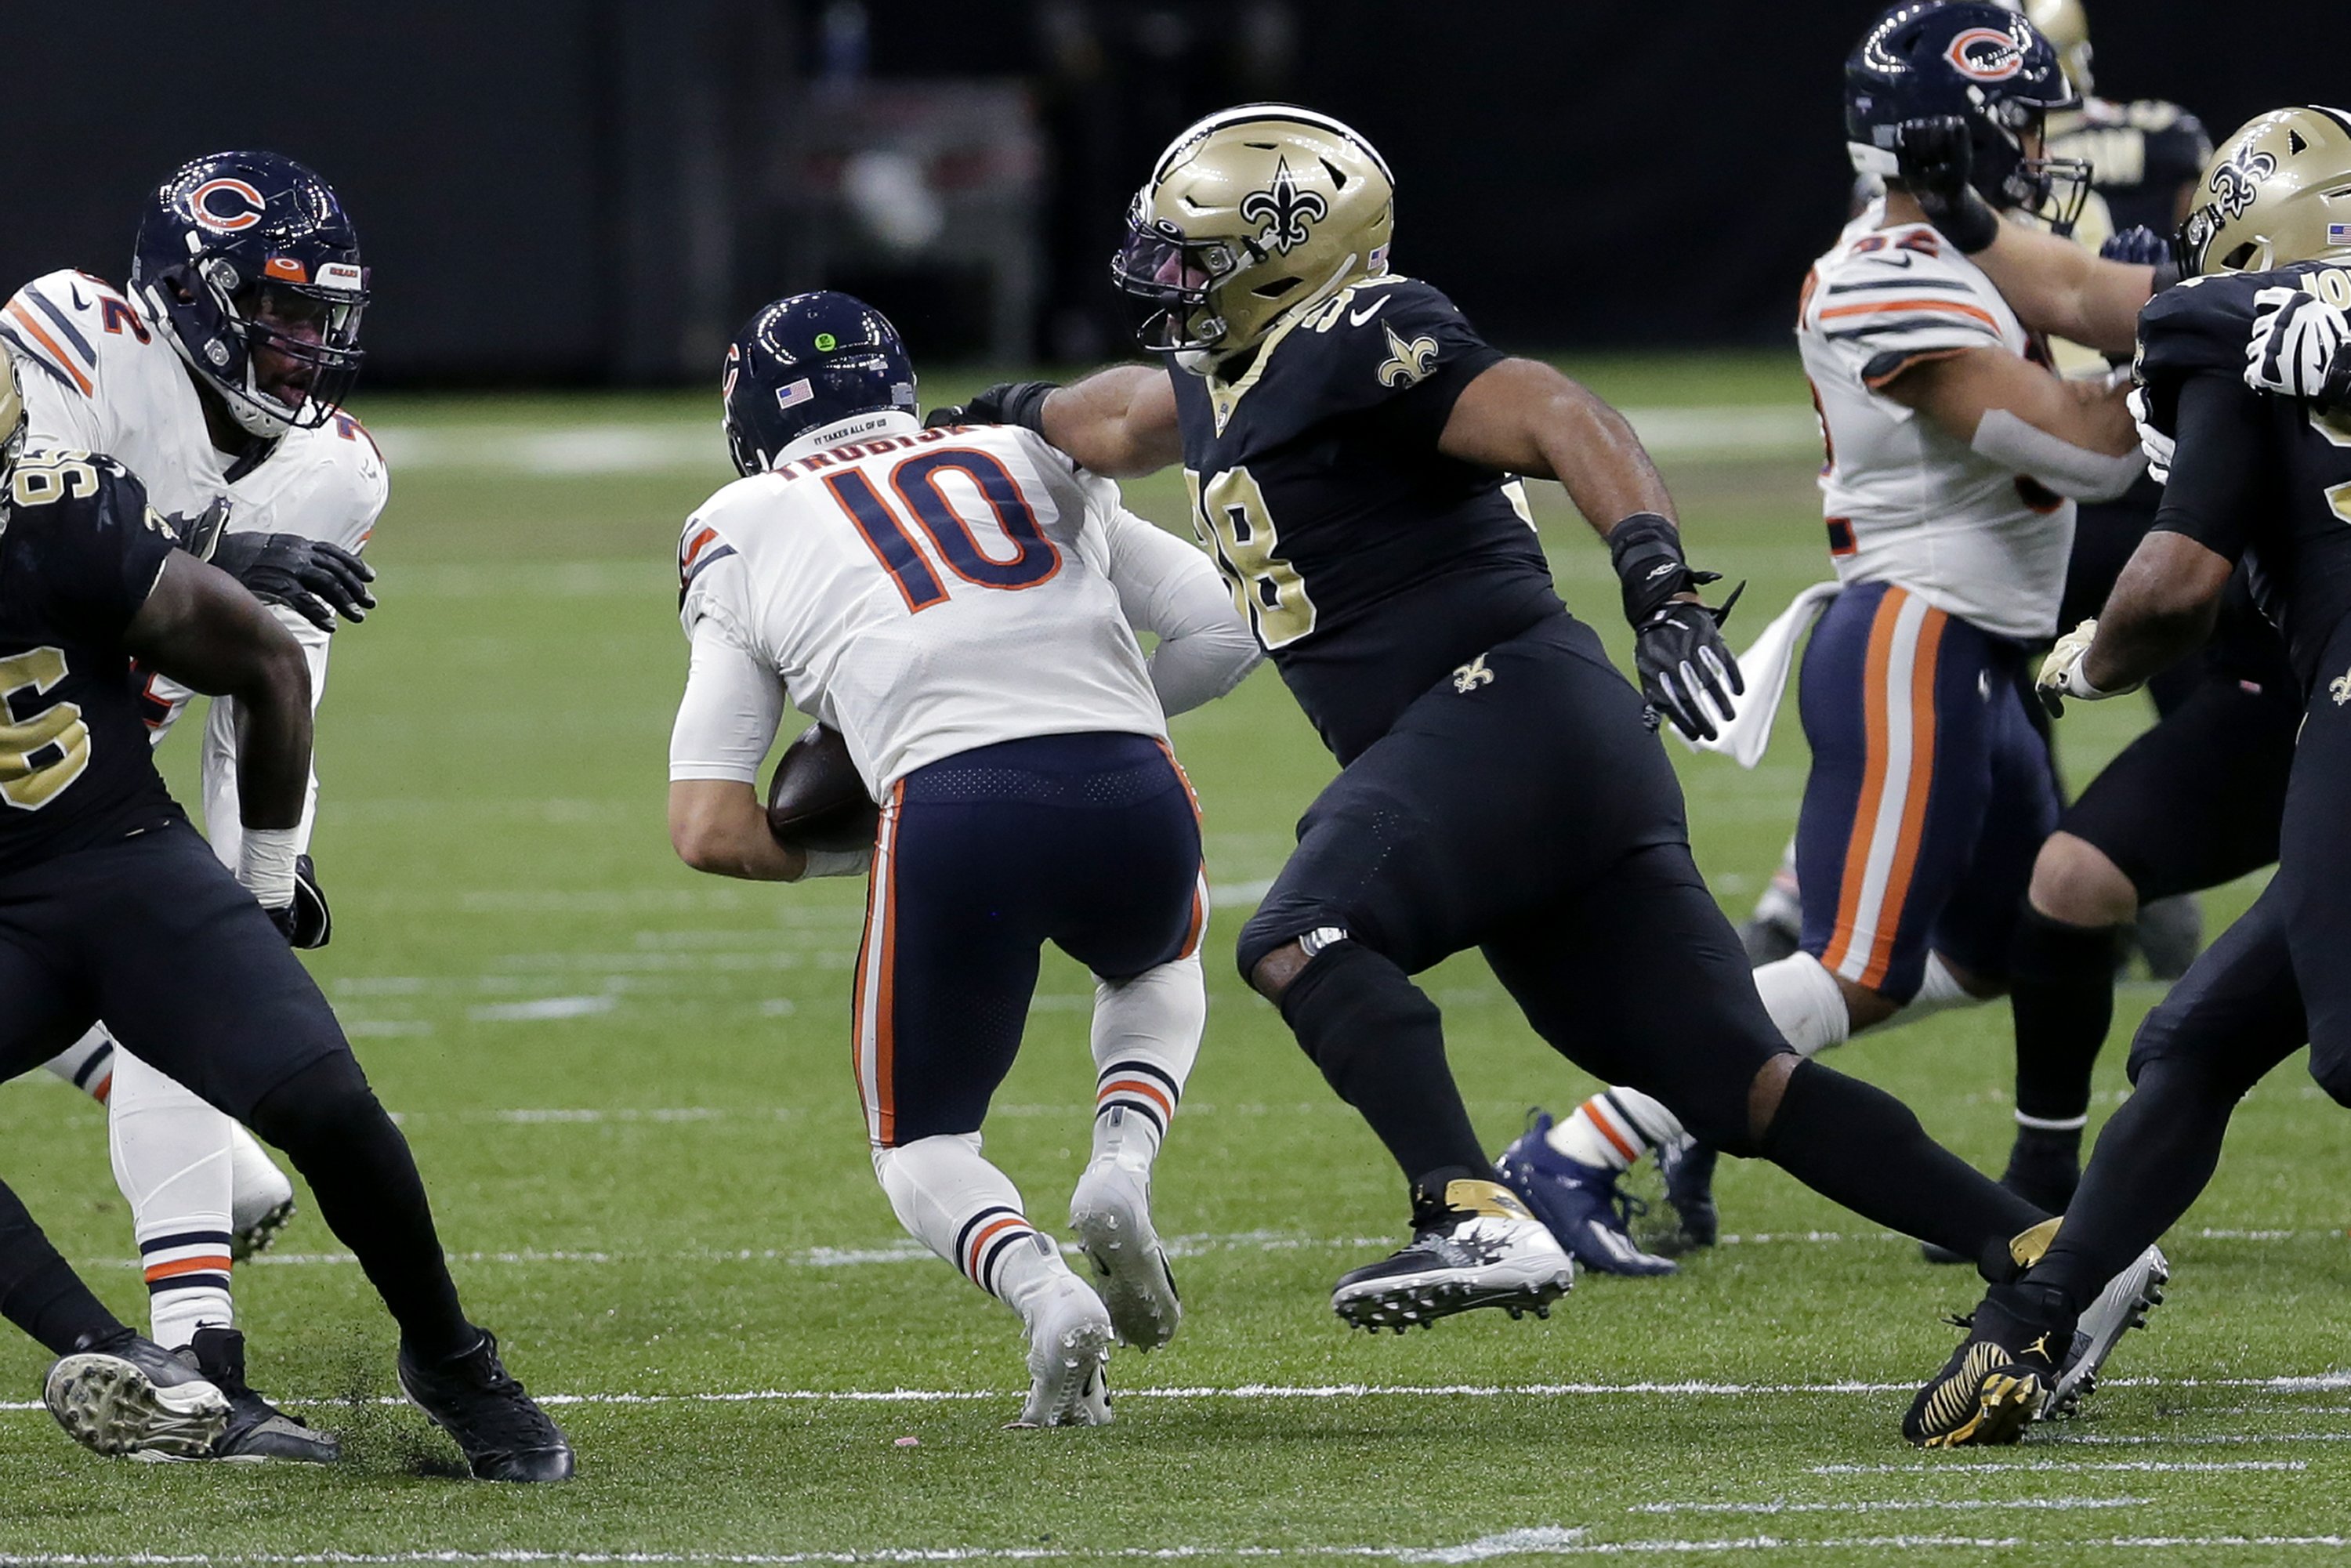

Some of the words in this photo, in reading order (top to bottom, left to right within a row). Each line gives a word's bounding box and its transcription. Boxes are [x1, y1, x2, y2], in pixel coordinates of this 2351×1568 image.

[190, 177, 266, 231] C
[813, 436, 823, 446] IT
[823, 429, 849, 442] TAKES
[850, 424, 864, 435] ALL
[865, 420, 876, 429] OF
[820, 447, 1062, 615] 10
